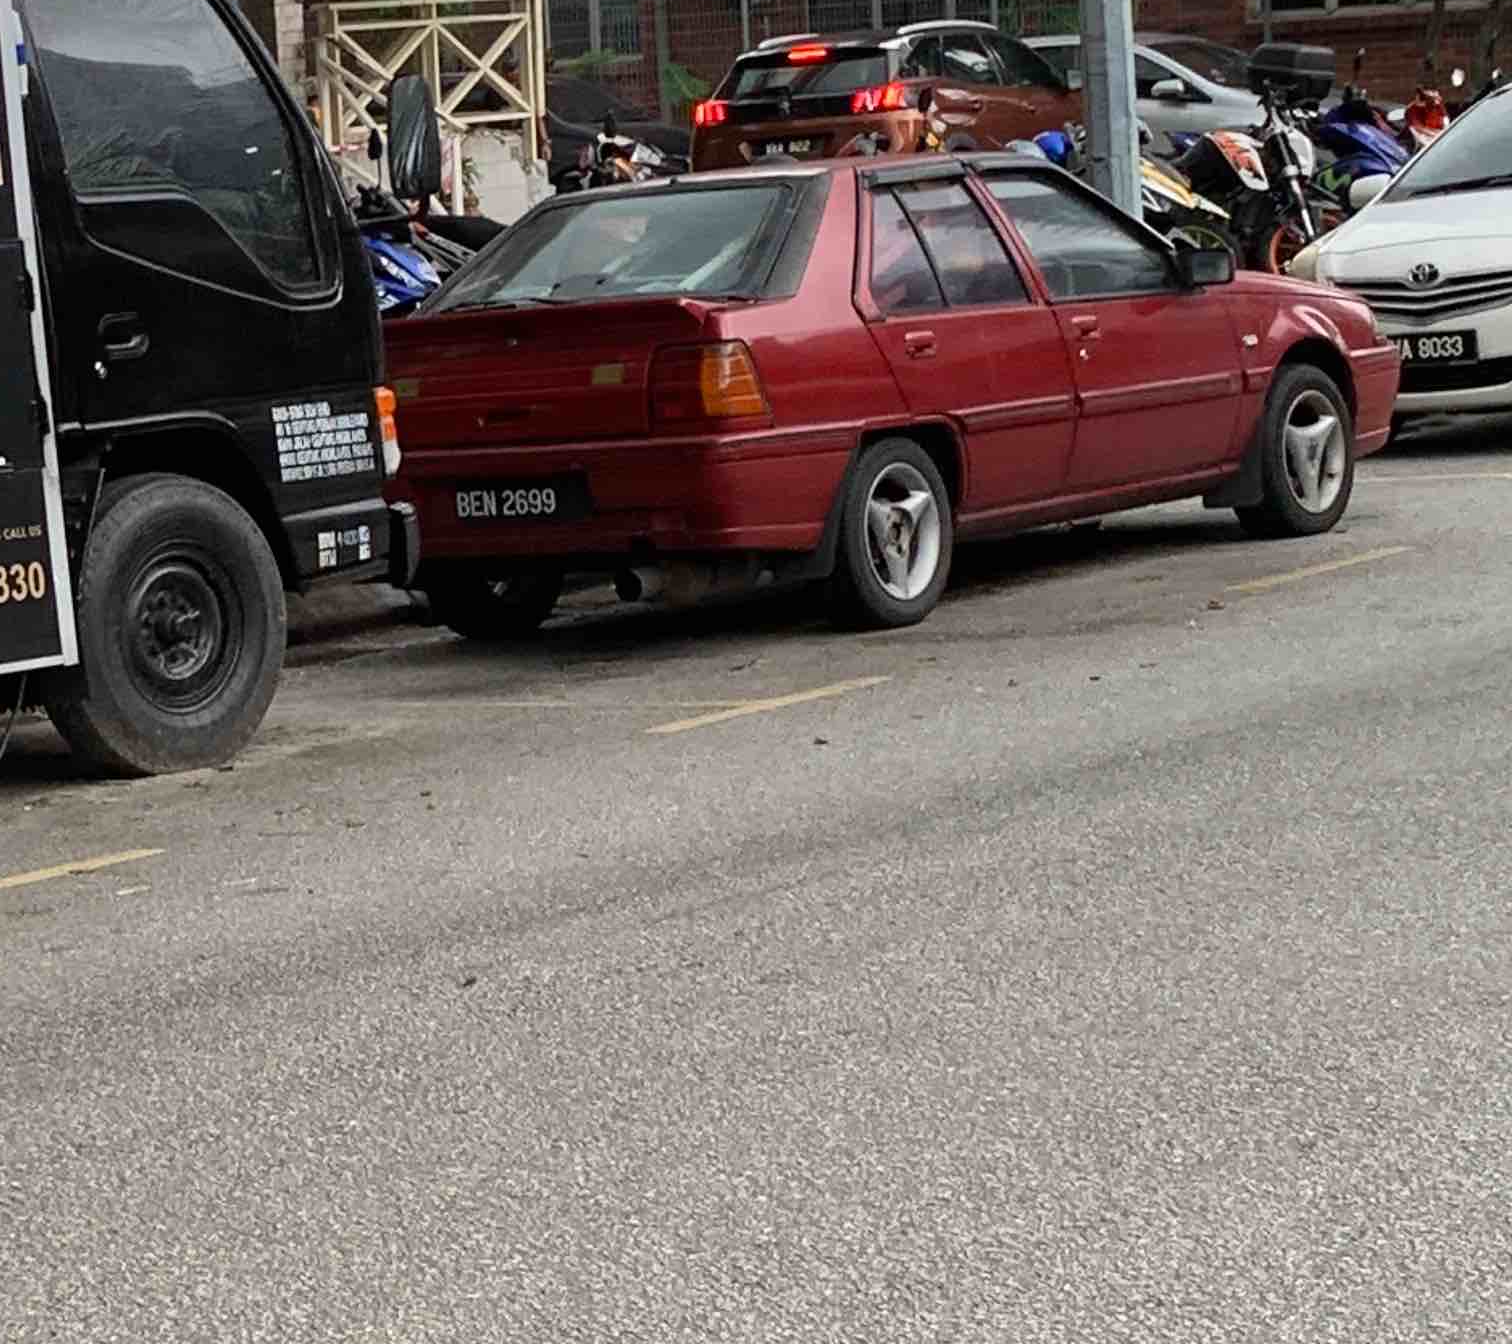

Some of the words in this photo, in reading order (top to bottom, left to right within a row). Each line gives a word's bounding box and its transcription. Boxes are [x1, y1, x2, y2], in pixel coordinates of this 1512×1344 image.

[1418, 335, 1464, 359] 8033
[456, 490, 498, 519] BEN
[501, 487, 558, 516] 2699
[3, 526, 28, 541] CALL
